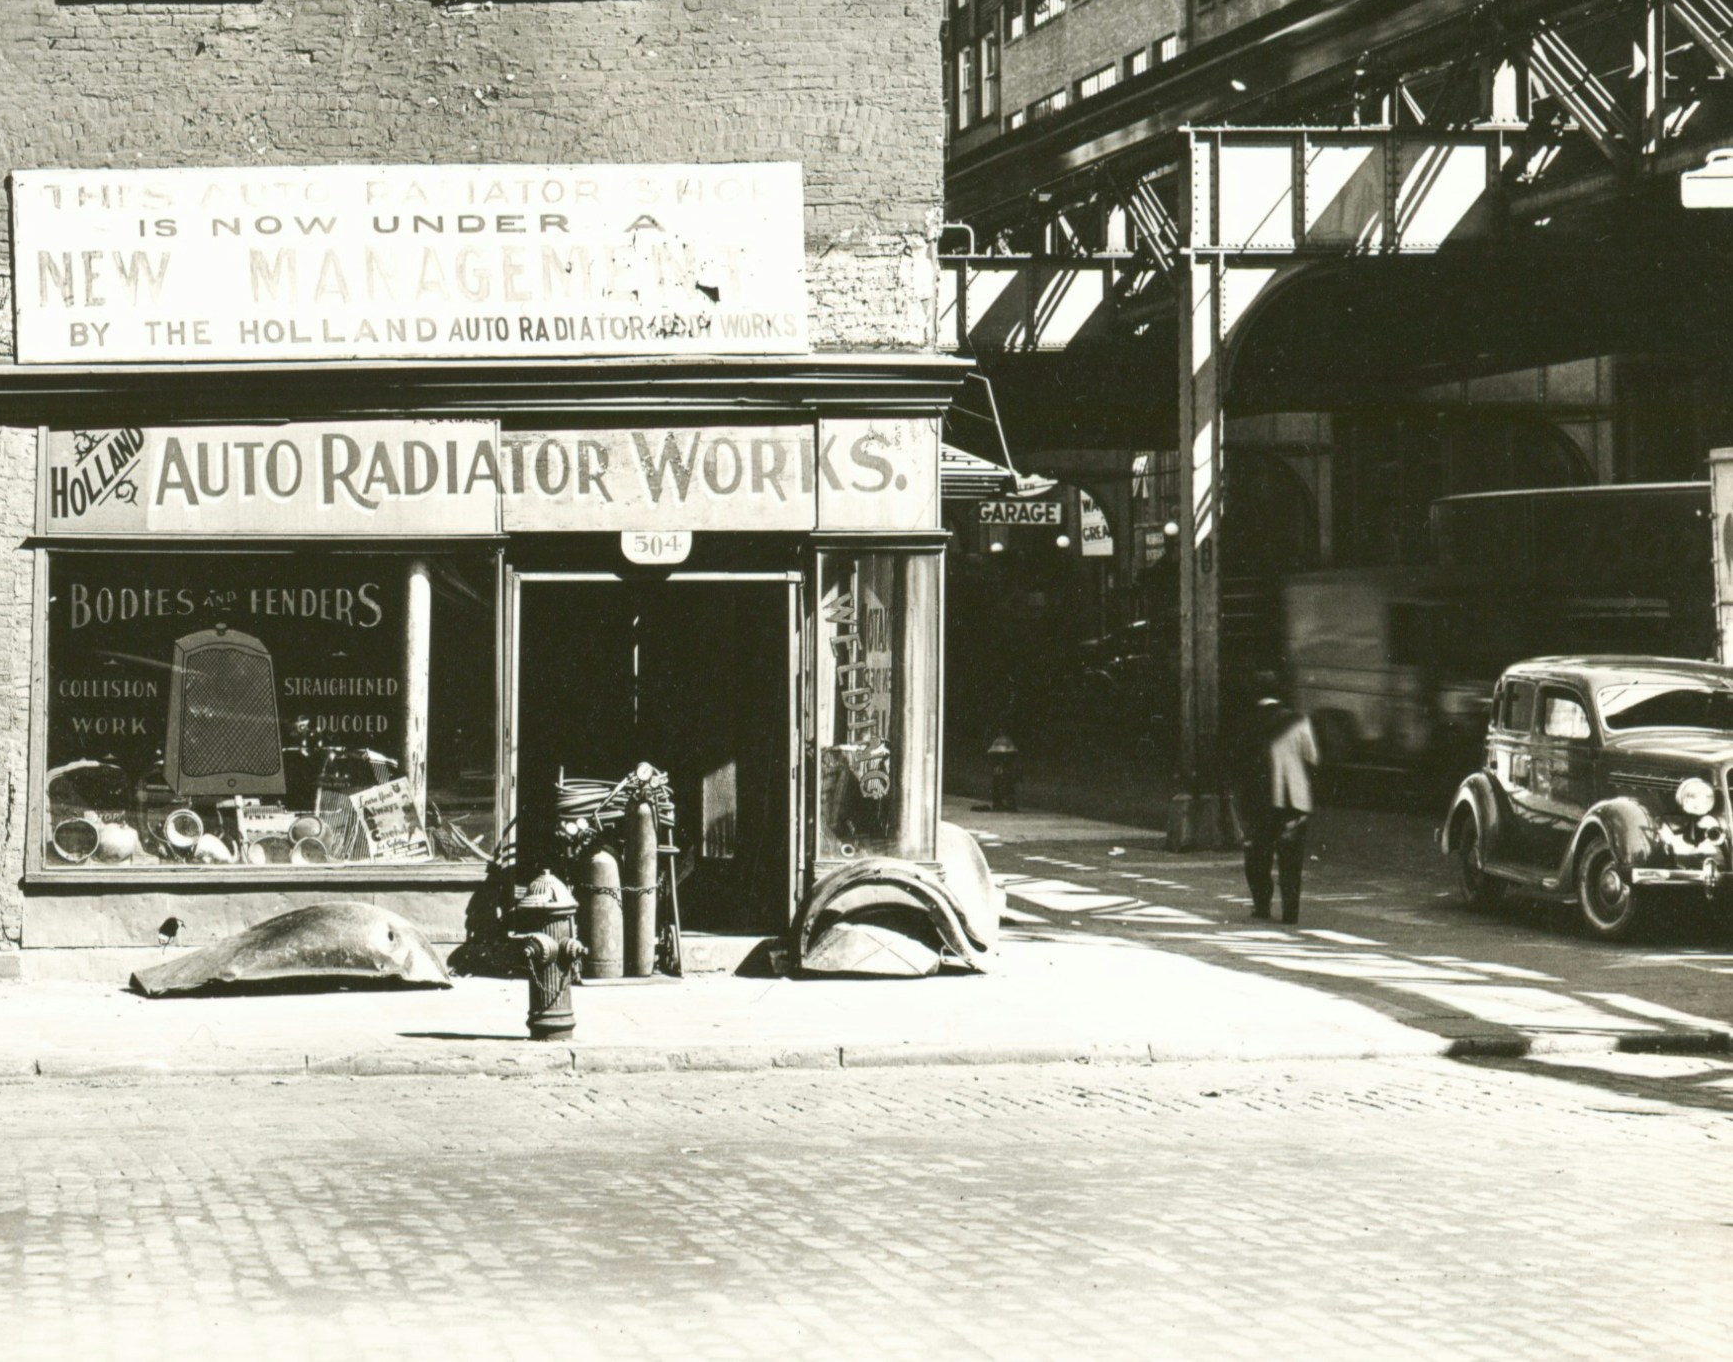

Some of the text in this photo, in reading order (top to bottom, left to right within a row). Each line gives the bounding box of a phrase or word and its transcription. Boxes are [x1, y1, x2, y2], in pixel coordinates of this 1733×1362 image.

[138, 214, 666, 238] IS NOW UNDER A
[38, 245, 747, 307] NEW MANAGEMENT
[69, 321, 111, 347] BY
[145, 320, 213, 346] THE
[239, 317, 437, 345] HOLLAND
[448, 317, 510, 342] AUTO
[519, 315, 646, 342] RADIATOR
[720, 313, 798, 339] WORKS
[51, 427, 145, 518] HOLLAND
[155, 431, 908, 510] AUTO RADIATOR WORKS.
[979, 503, 1058, 523] GARAGE
[634, 534, 683, 557] 504
[71, 582, 383, 629] BODIES AND FENDERS
[59, 678, 158, 699] COLLISION
[284, 677, 399, 696] STRAIGHTENED
[822, 591, 891, 799] WELDING
[72, 717, 147, 735] WORK
[316, 715, 388, 733] DUCOED
